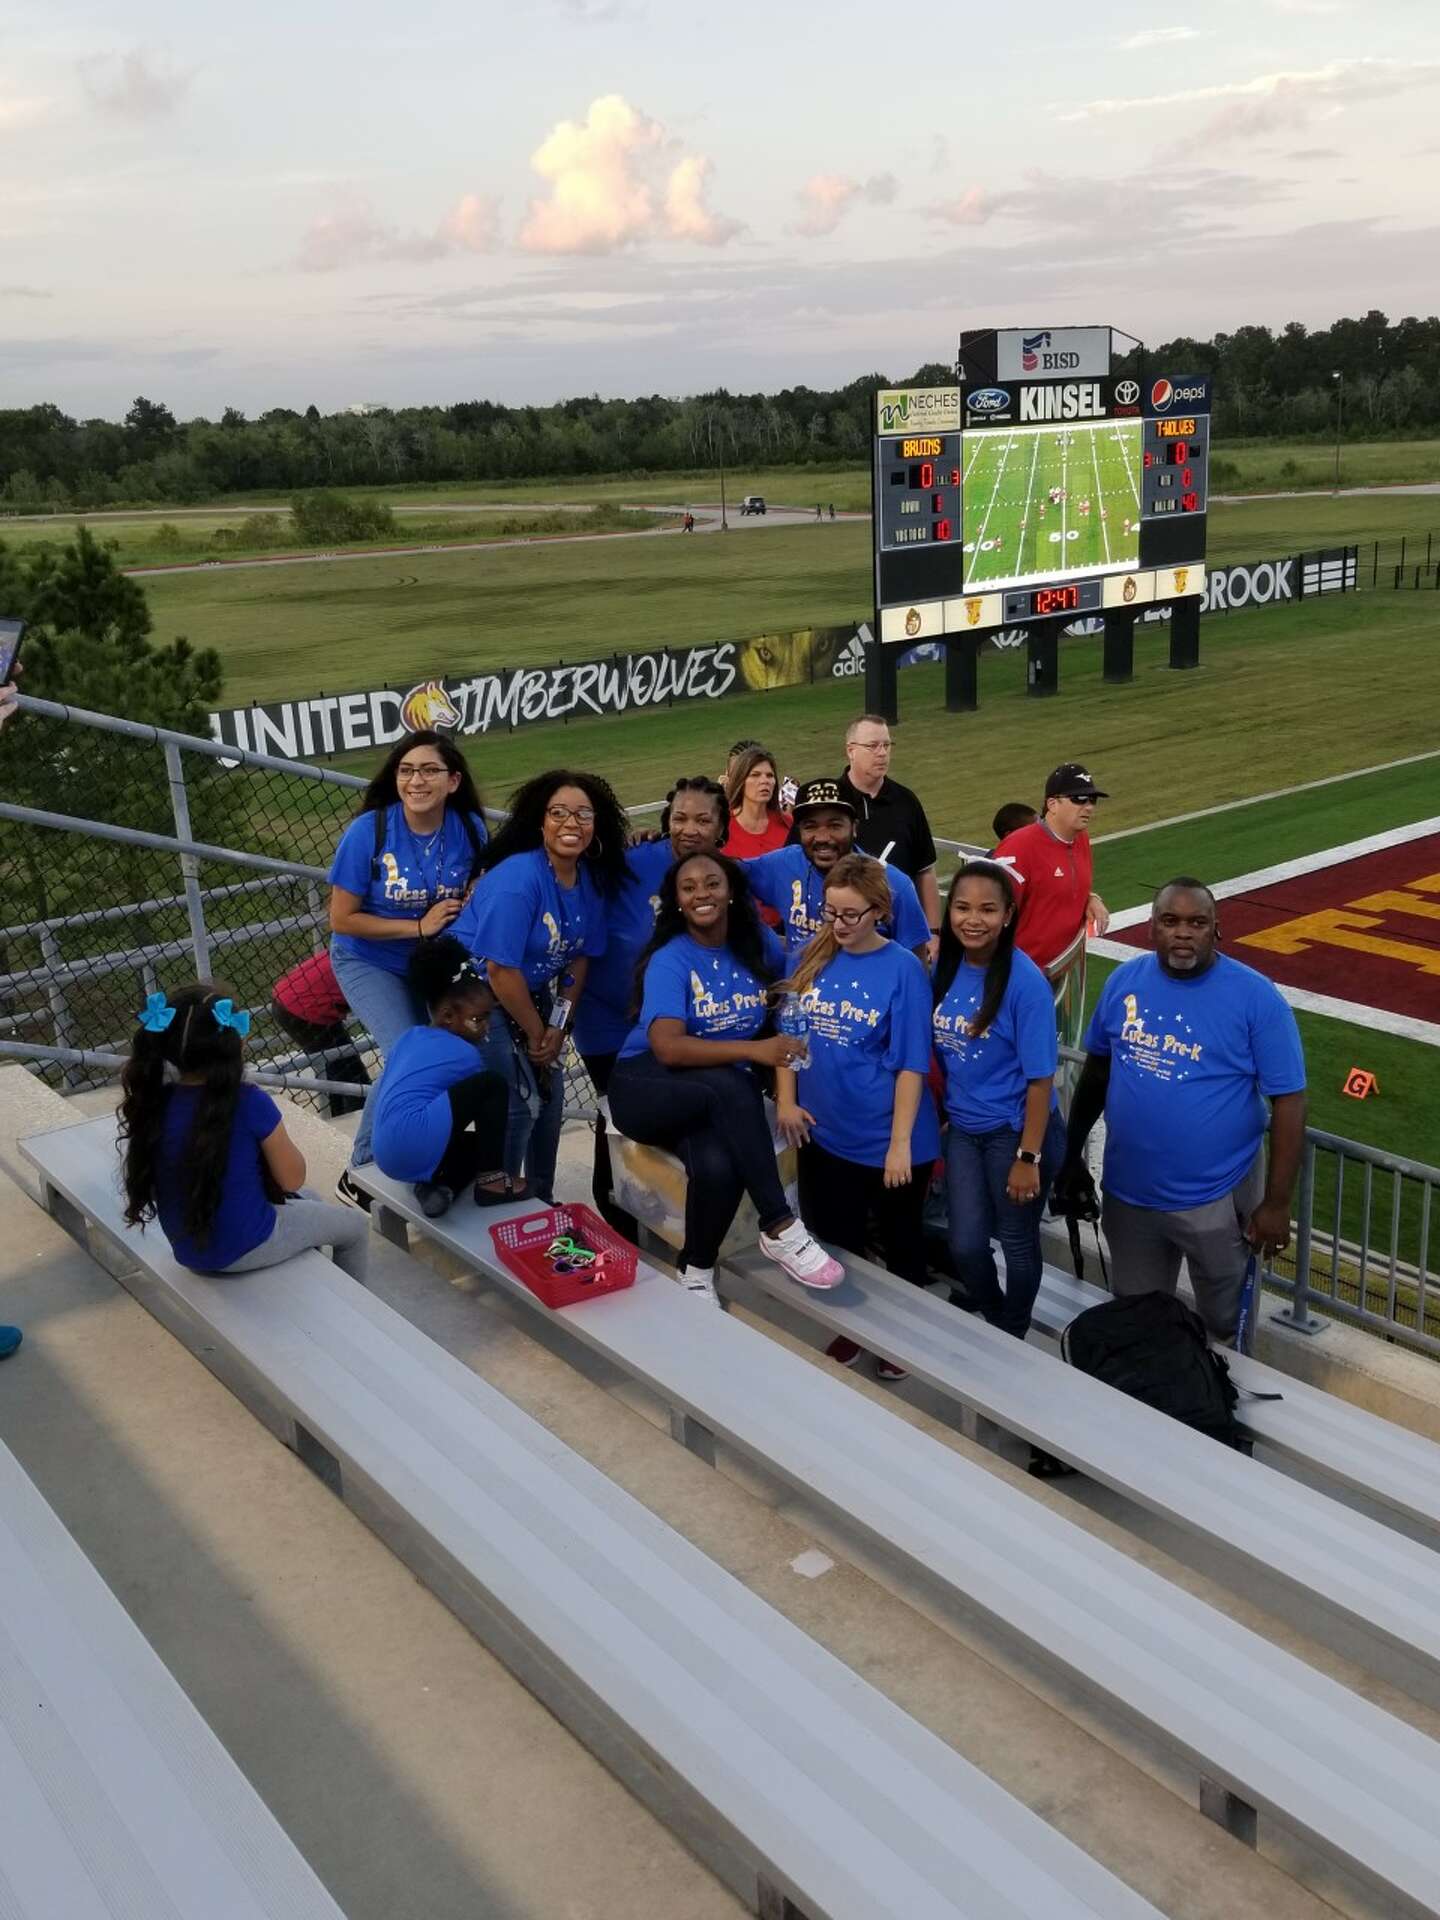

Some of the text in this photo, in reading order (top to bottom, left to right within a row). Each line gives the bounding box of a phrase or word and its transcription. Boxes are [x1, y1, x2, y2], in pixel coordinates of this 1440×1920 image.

[1042, 352, 1080, 370] BISD
[908, 393, 959, 409] NECHES
[975, 391, 1003, 409] Ford
[1020, 383, 1106, 421] KINSEL
[1173, 384, 1206, 403] pepsi
[903, 438, 941, 457] BRUINS
[921, 464, 933, 488] 0
[1037, 586, 1077, 614] 12:47
[832, 655, 867, 677] adi
[209, 643, 736, 768] UNITED TIMBERWOLVES
[695, 997, 730, 1018] Lucas
[732, 989, 768, 1011] Pre-K
[840, 1000, 880, 1028] Pre-K
[1121, 1026, 1203, 1062] Lucas Pre-K
[1348, 1073, 1369, 1097] G
